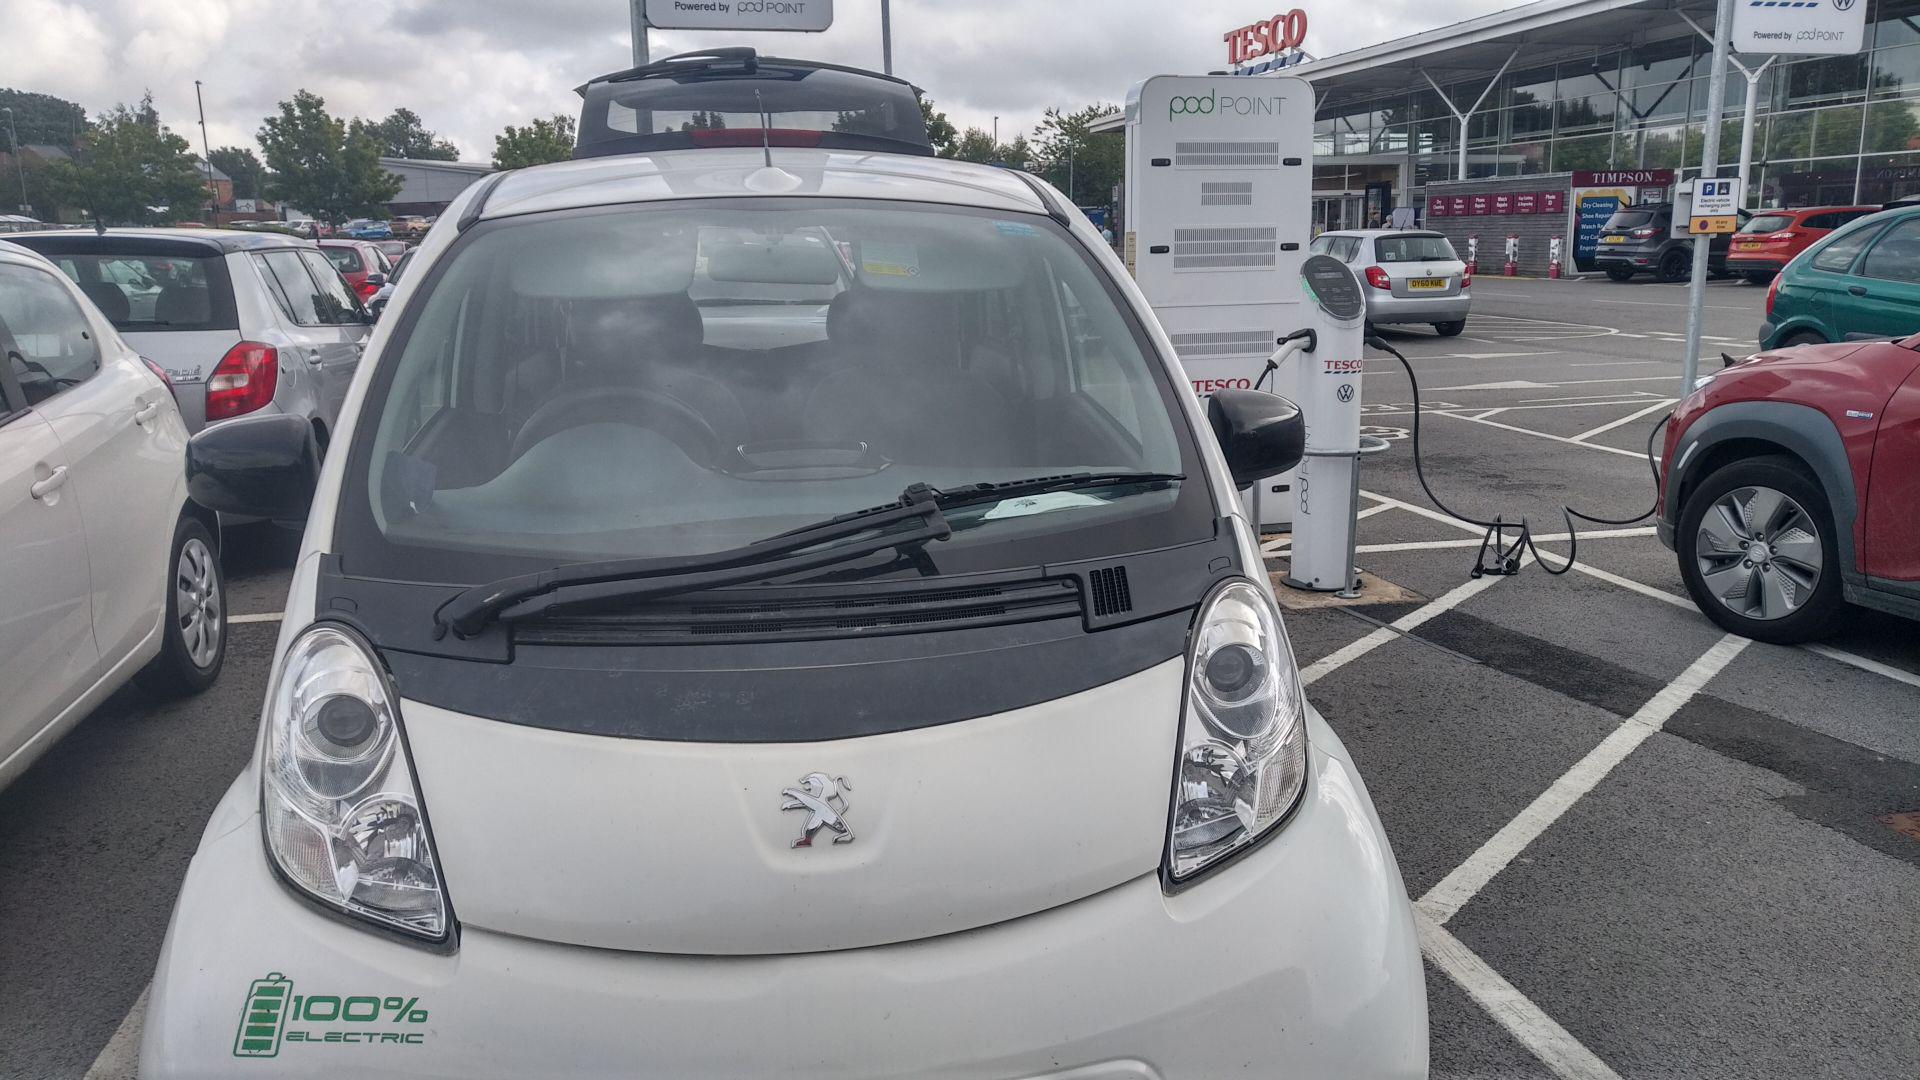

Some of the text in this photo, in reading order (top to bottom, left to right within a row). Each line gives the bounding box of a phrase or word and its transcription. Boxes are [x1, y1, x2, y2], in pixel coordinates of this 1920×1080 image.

[674, 0, 806, 16] Powered by pod POINT
[1223, 8, 1308, 65] TESCO
[1753, 28, 1844, 44] Powered by pod POINT
[1169, 88, 1288, 122] pod POINT
[1592, 171, 1654, 184] TIMPSON
[1706, 185, 1712, 193] P
[1592, 201, 1614, 209] Cleaning
[1324, 359, 1362, 370] TESCO
[1192, 378, 1250, 392] TESCO
[292, 995, 428, 1023] 100%
[286, 1031, 424, 1044] ELECTRIC
